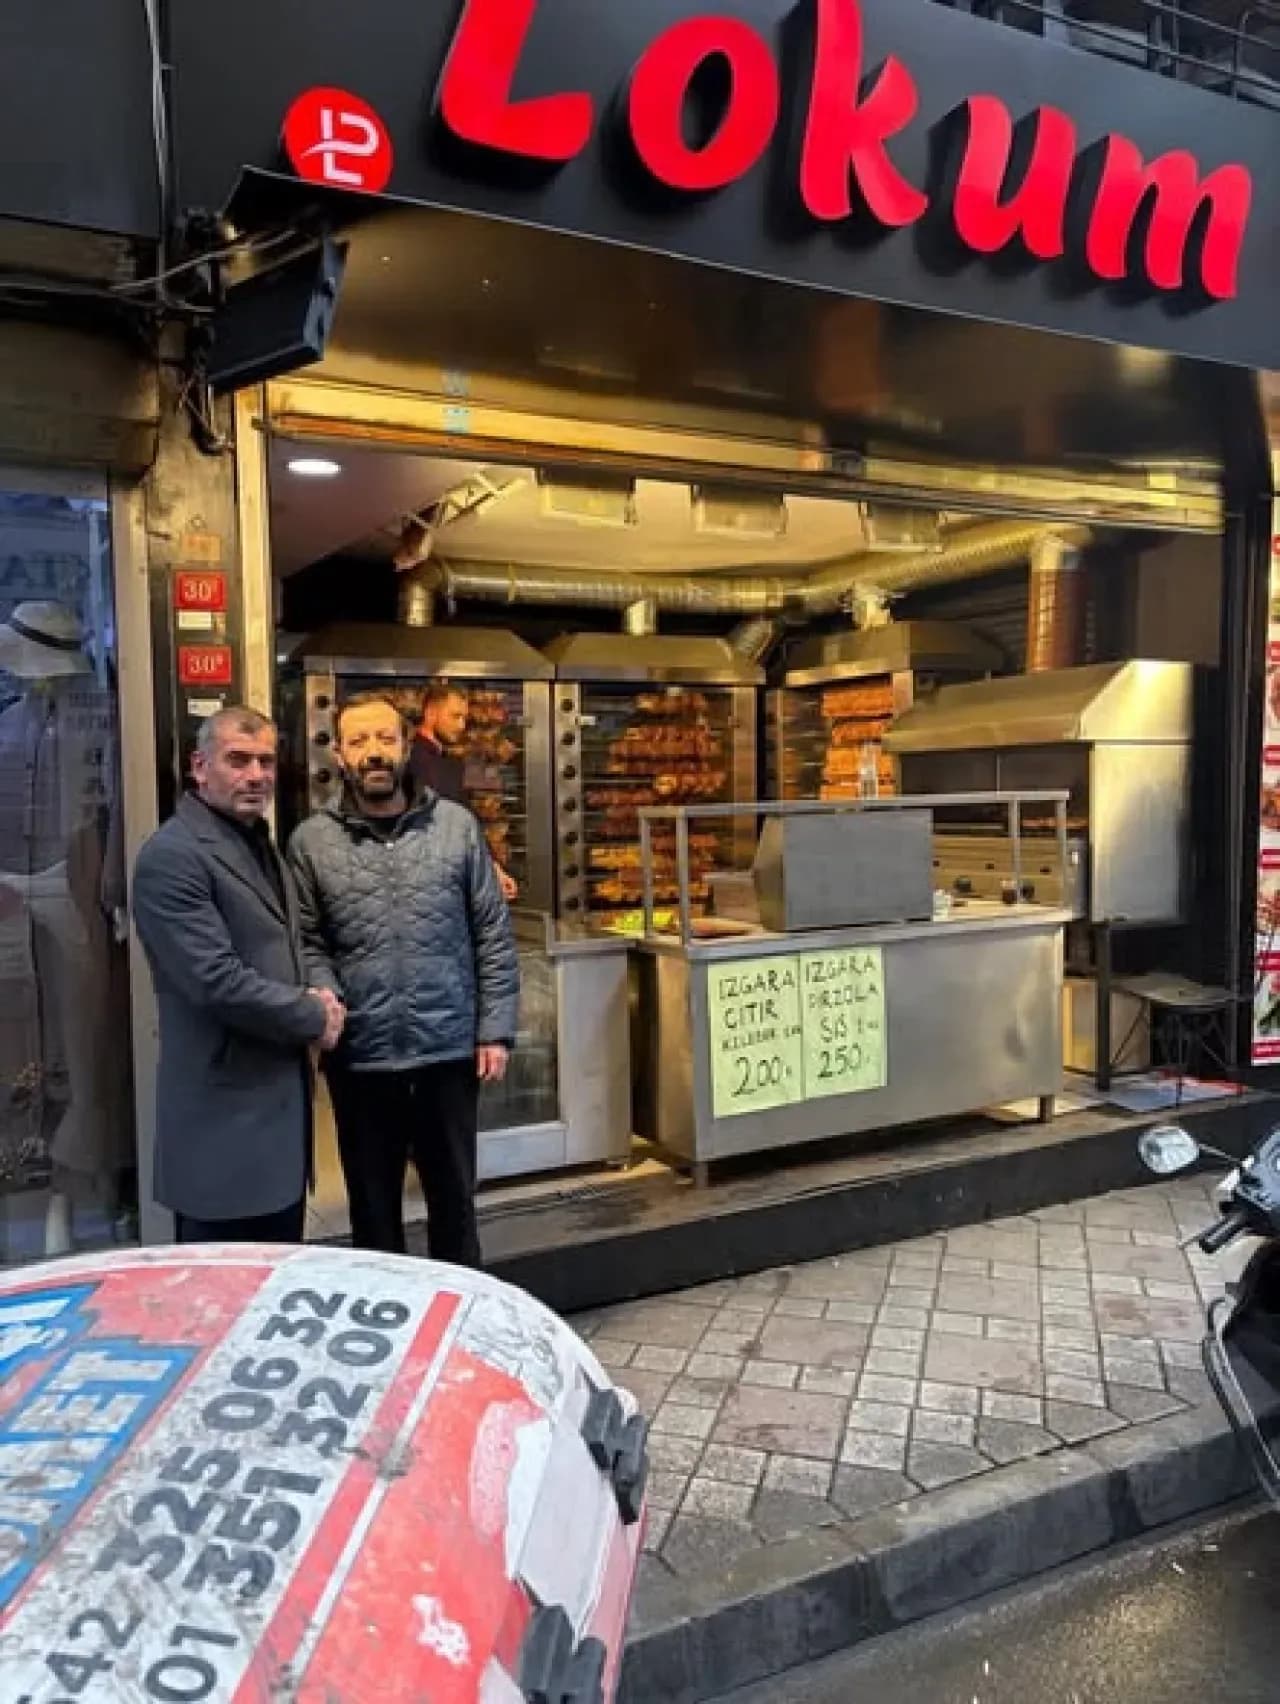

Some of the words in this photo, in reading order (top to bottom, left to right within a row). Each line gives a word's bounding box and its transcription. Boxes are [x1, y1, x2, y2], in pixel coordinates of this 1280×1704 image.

[438, 0, 1252, 300] Lokum
[17, 1608, 147, 1704] 42
[97, 1445, 241, 1583] 325
[201, 1355, 300, 1433] 06
[257, 1287, 348, 1348] 32
[183, 1466, 323, 1601] 351
[271, 1376, 372, 1460] 32
[327, 1297, 412, 1368] 06
